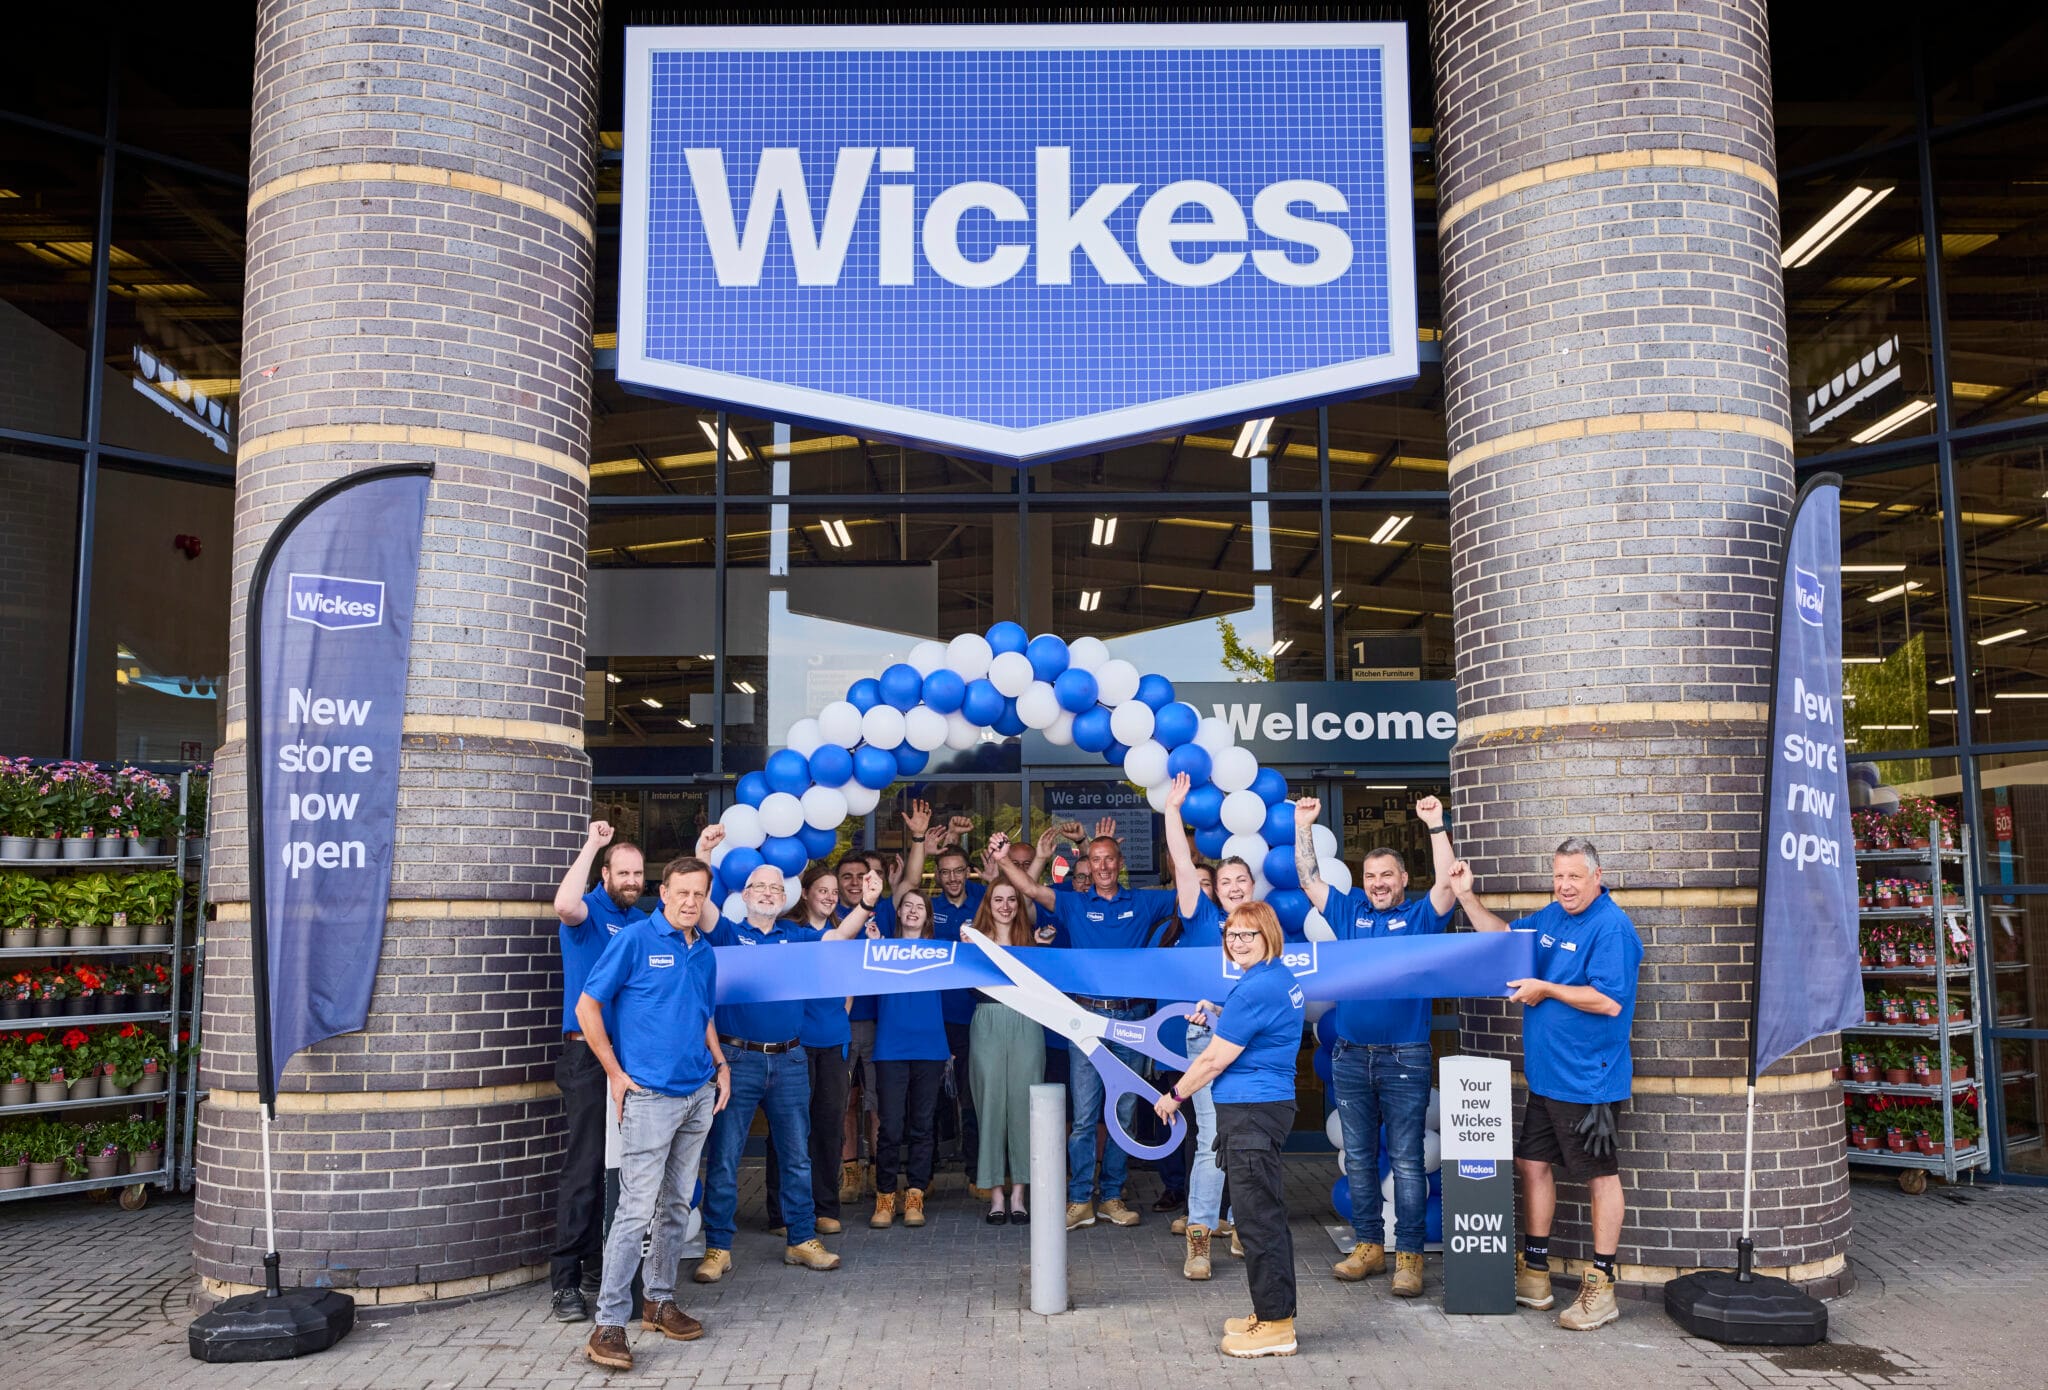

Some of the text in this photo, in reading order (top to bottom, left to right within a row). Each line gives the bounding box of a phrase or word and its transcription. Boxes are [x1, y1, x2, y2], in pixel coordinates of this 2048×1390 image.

[684, 146, 1354, 288] Wickes
[296, 592, 376, 617] Wickes
[1354, 641, 1365, 664] 1
[1355, 670, 1414, 678] Kitchen Furniture
[289, 688, 372, 726] New
[1212, 703, 1457, 741] Welcome
[1784, 732, 1838, 774] sore
[652, 792, 703, 800] Interior Paint
[1051, 792, 1141, 808] We are open
[1384, 799, 1398, 809] 11
[1788, 783, 1835, 819] now
[1360, 808, 1373, 819] 12
[1781, 832, 1839, 871] open
[872, 945, 949, 962] Wickes
[1460, 1079, 1491, 1092] Your
[1462, 1099, 1490, 1109] new
[1451, 1114, 1502, 1127] Wickes
[1459, 1130, 1495, 1142] store
[1461, 1165, 1494, 1174] Wickes
[1454, 1213, 1503, 1232] NOW
[1451, 1235, 1507, 1254] OPEN
